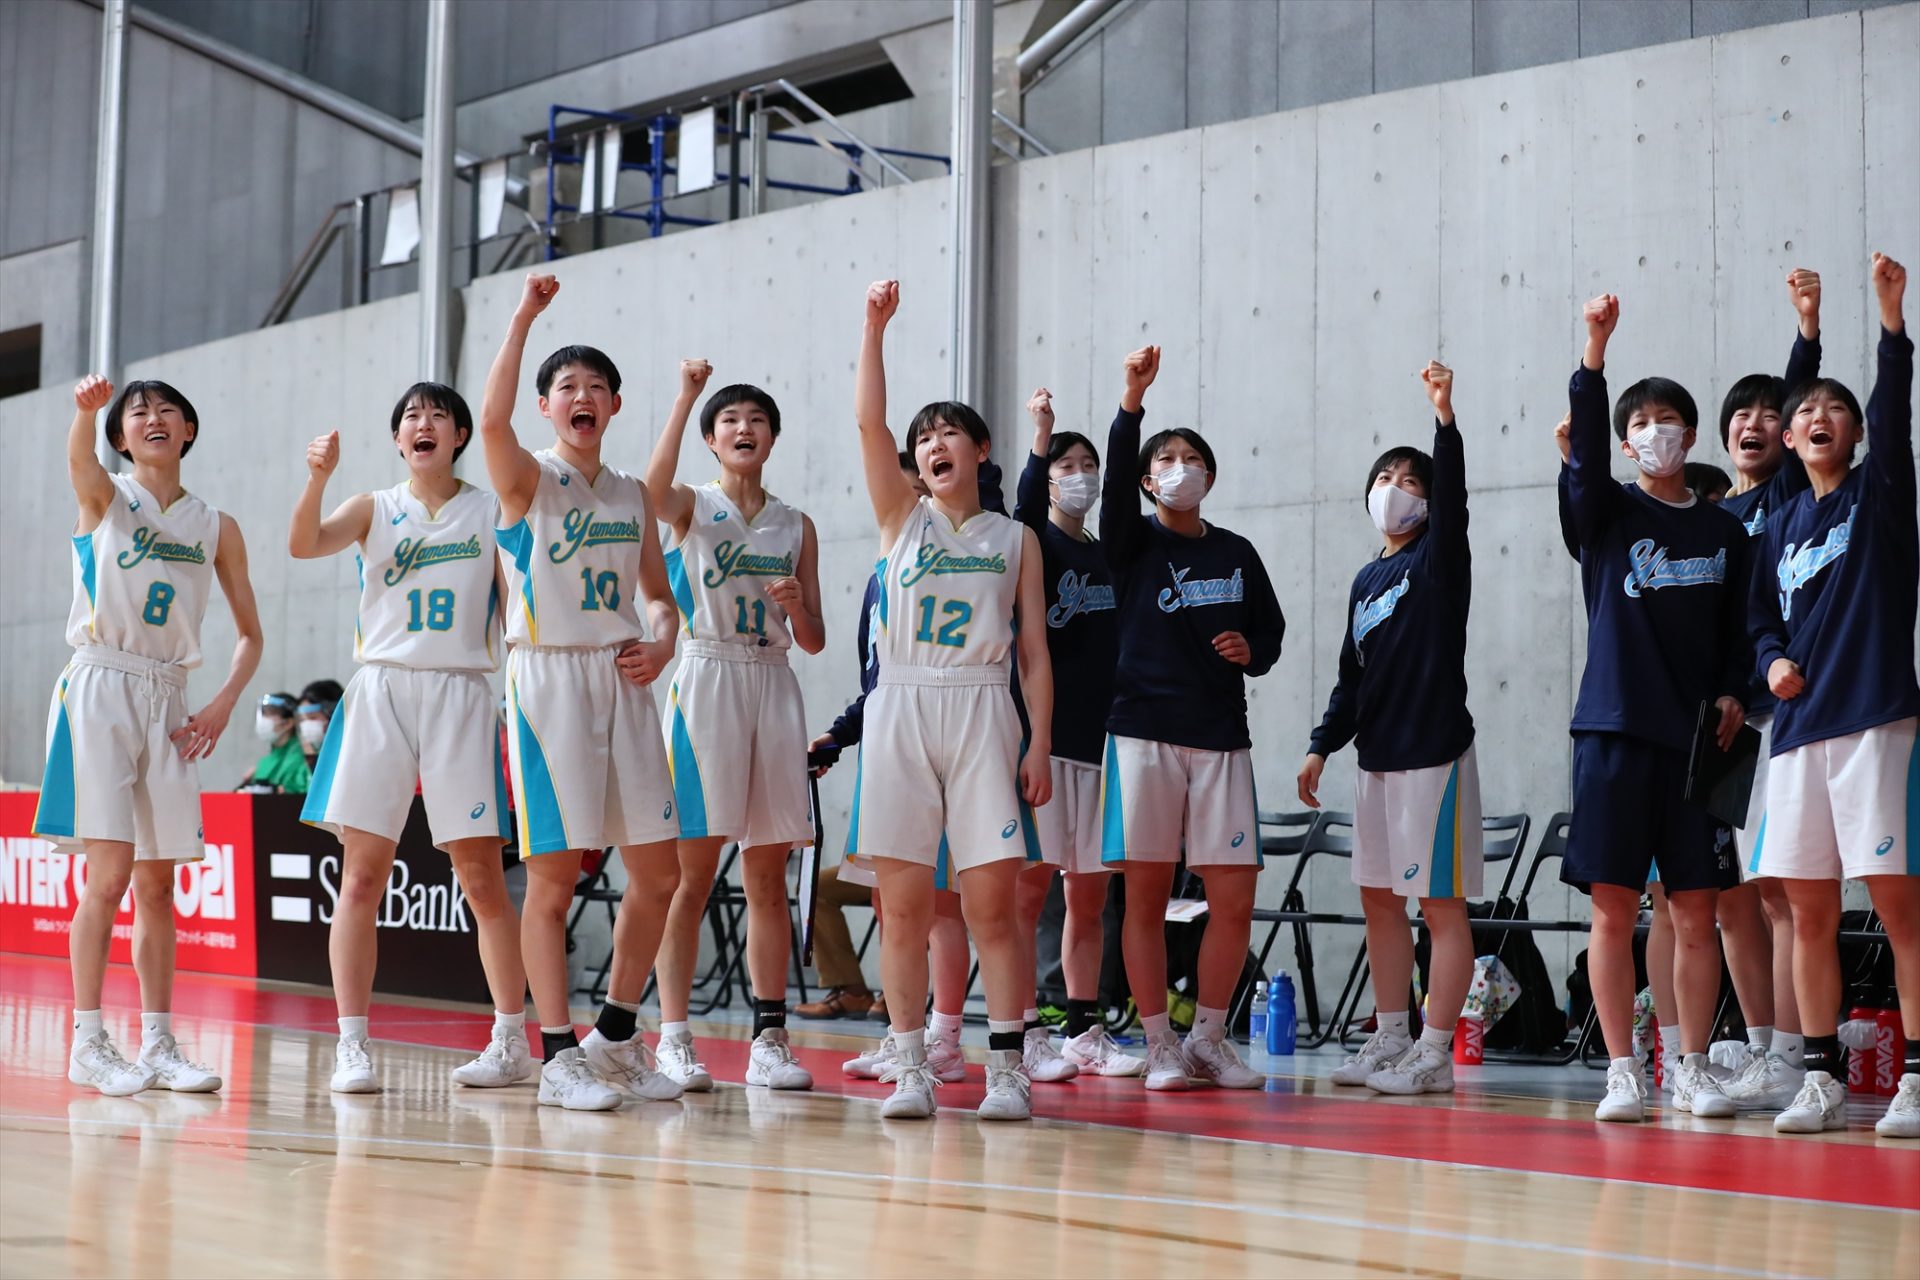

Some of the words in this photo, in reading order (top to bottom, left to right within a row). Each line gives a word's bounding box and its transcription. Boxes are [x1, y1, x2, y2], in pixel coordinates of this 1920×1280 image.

[117, 526, 207, 570] Yamanote
[384, 533, 483, 588] Yamanote
[900, 542, 1008, 589] Yamanote
[142, 581, 176, 628] 8
[406, 588, 456, 632] 18
[580, 566, 621, 612] 10
[735, 595, 767, 637] 11
[915, 594, 973, 649] 12
[318, 855, 471, 934] SBank
[1465, 1018, 1483, 1058] SAV
[1876, 1025, 1895, 1089] SAVAS
[1848, 1047, 1864, 1086] SAV
